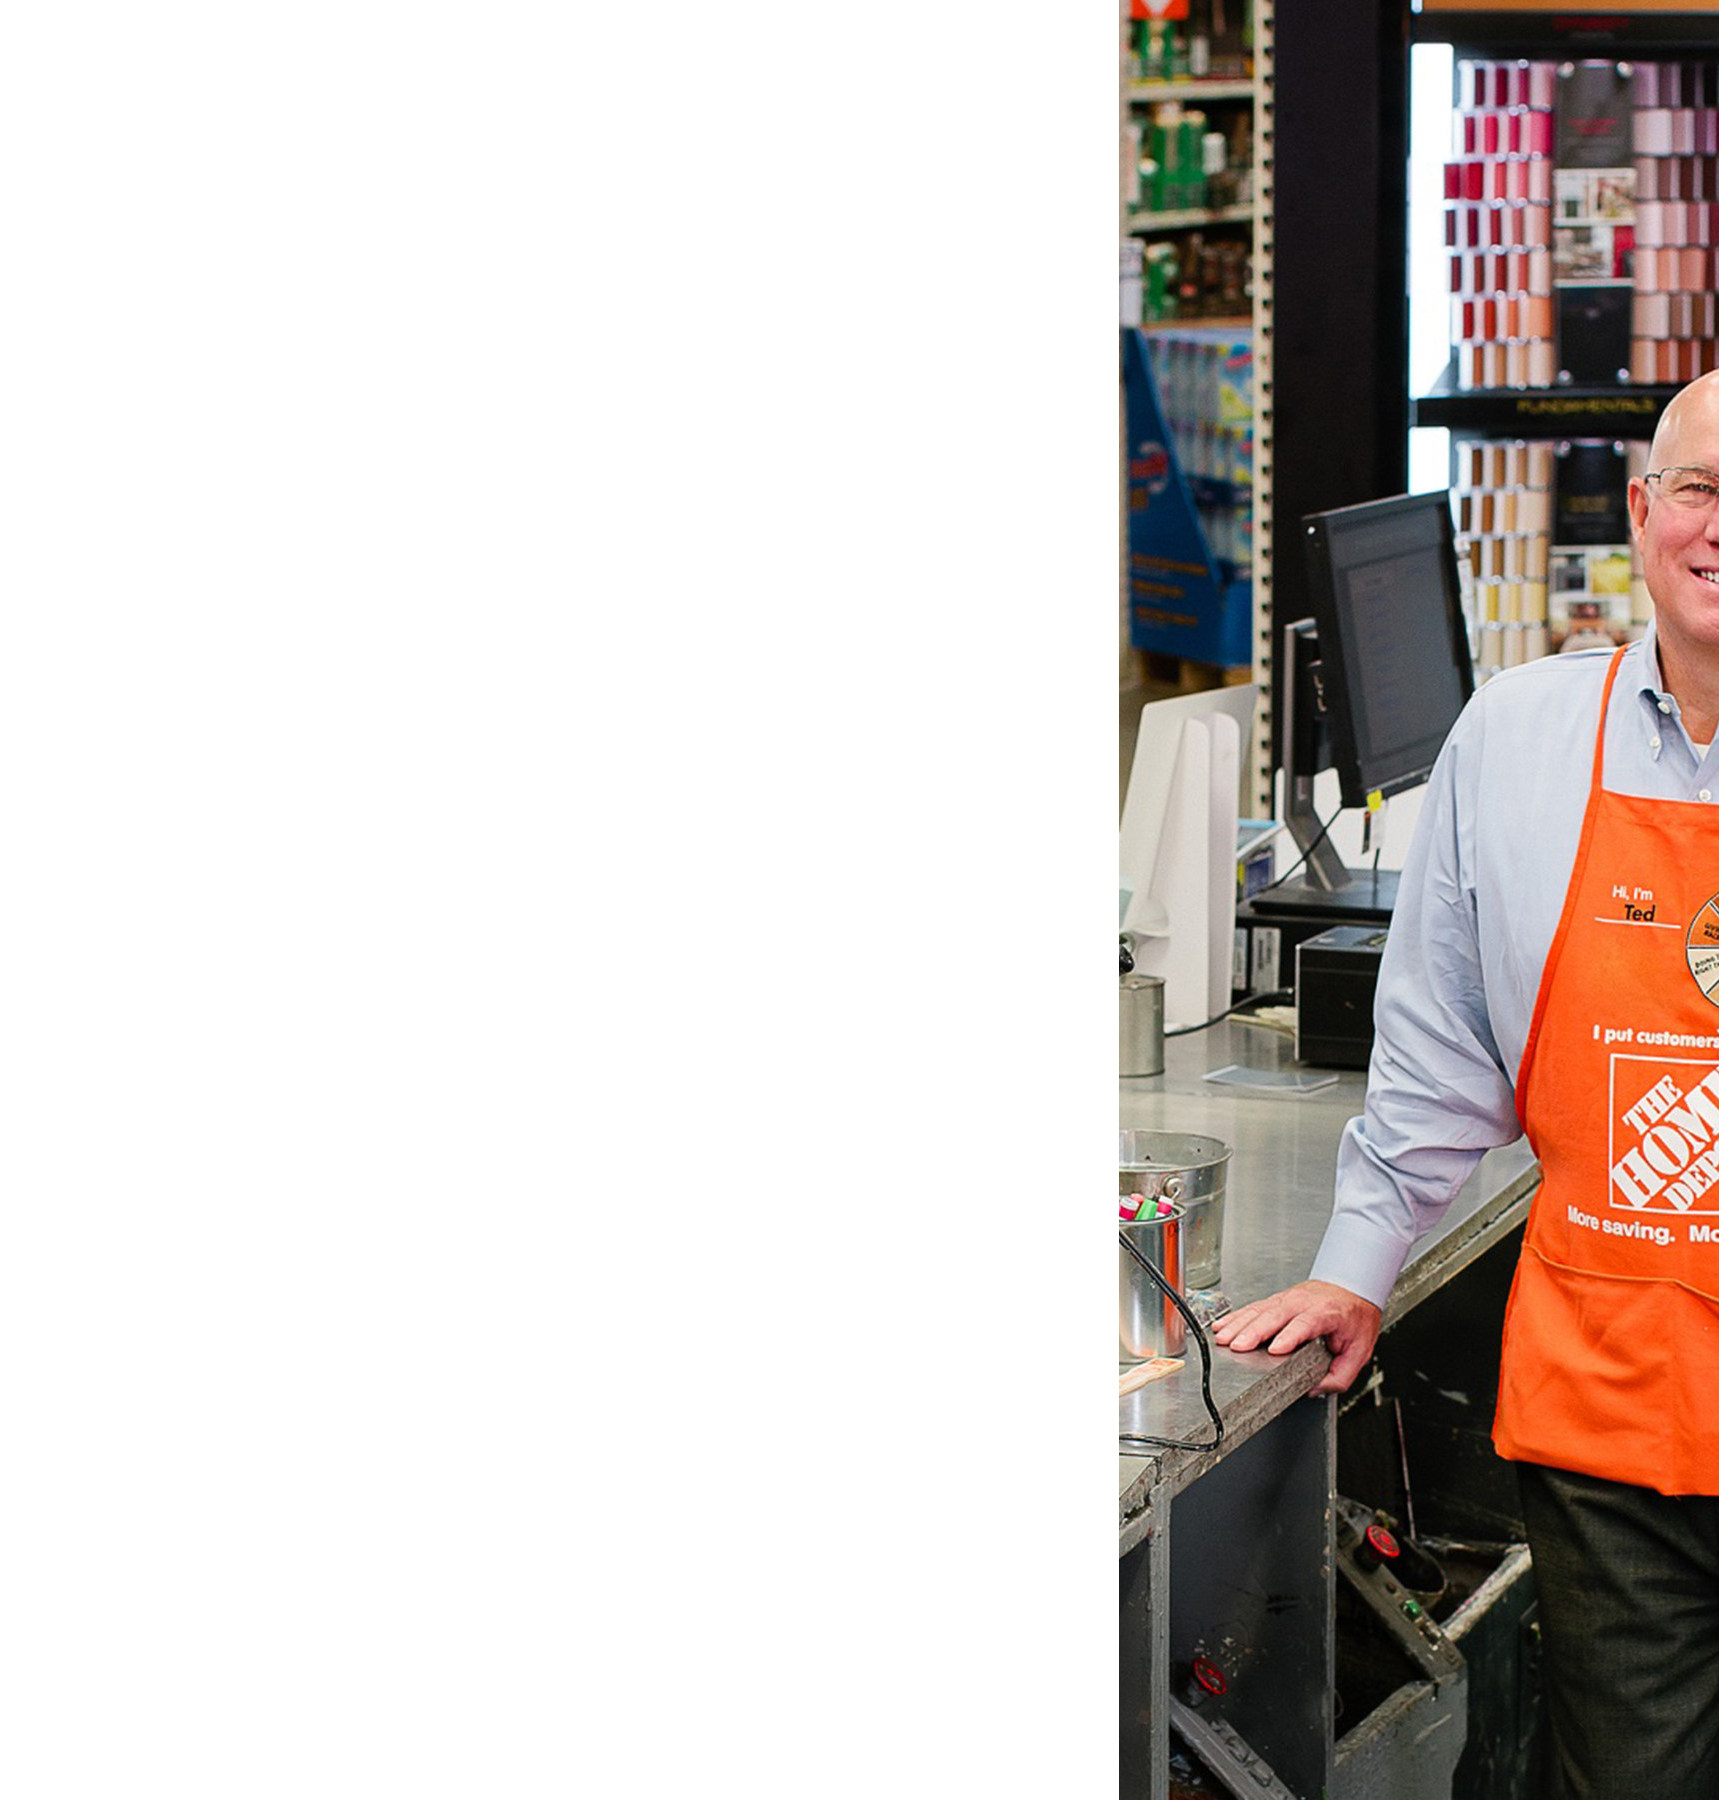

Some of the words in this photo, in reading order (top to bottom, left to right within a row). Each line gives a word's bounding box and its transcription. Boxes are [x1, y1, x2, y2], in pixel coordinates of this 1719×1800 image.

[1612, 884, 1630, 901] Hi,
[1633, 887, 1653, 900] I'm
[1625, 903, 1656, 922] Ted
[1593, 1025, 1599, 1039] I
[1605, 1028, 1632, 1044] put
[1622, 1074, 1683, 1135] THE
[1568, 1205, 1599, 1230] More
[1602, 1219, 1676, 1245] saving.
